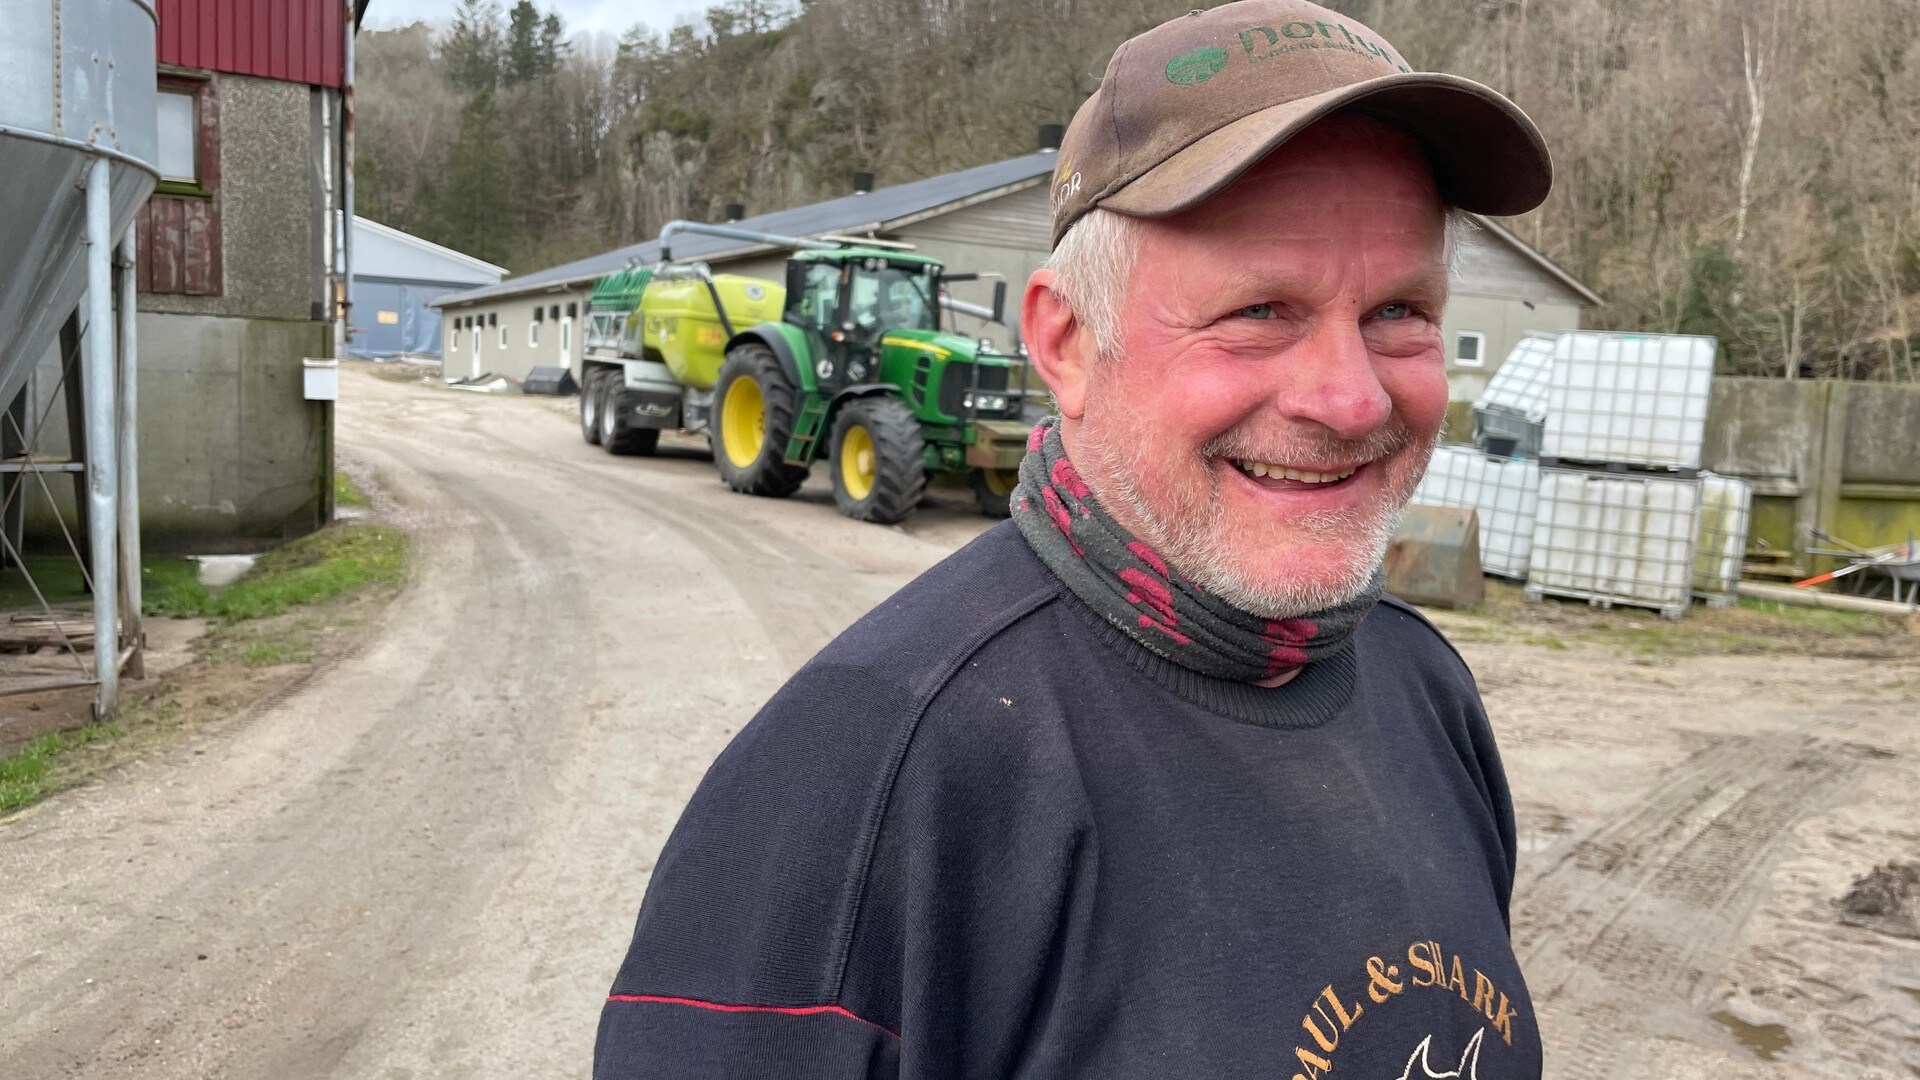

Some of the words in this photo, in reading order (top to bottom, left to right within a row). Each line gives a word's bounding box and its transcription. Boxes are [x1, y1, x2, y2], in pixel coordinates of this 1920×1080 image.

[1292, 984, 1364, 1080] AUL
[1366, 956, 1404, 1004] &
[1408, 940, 1518, 1046] SHARK
